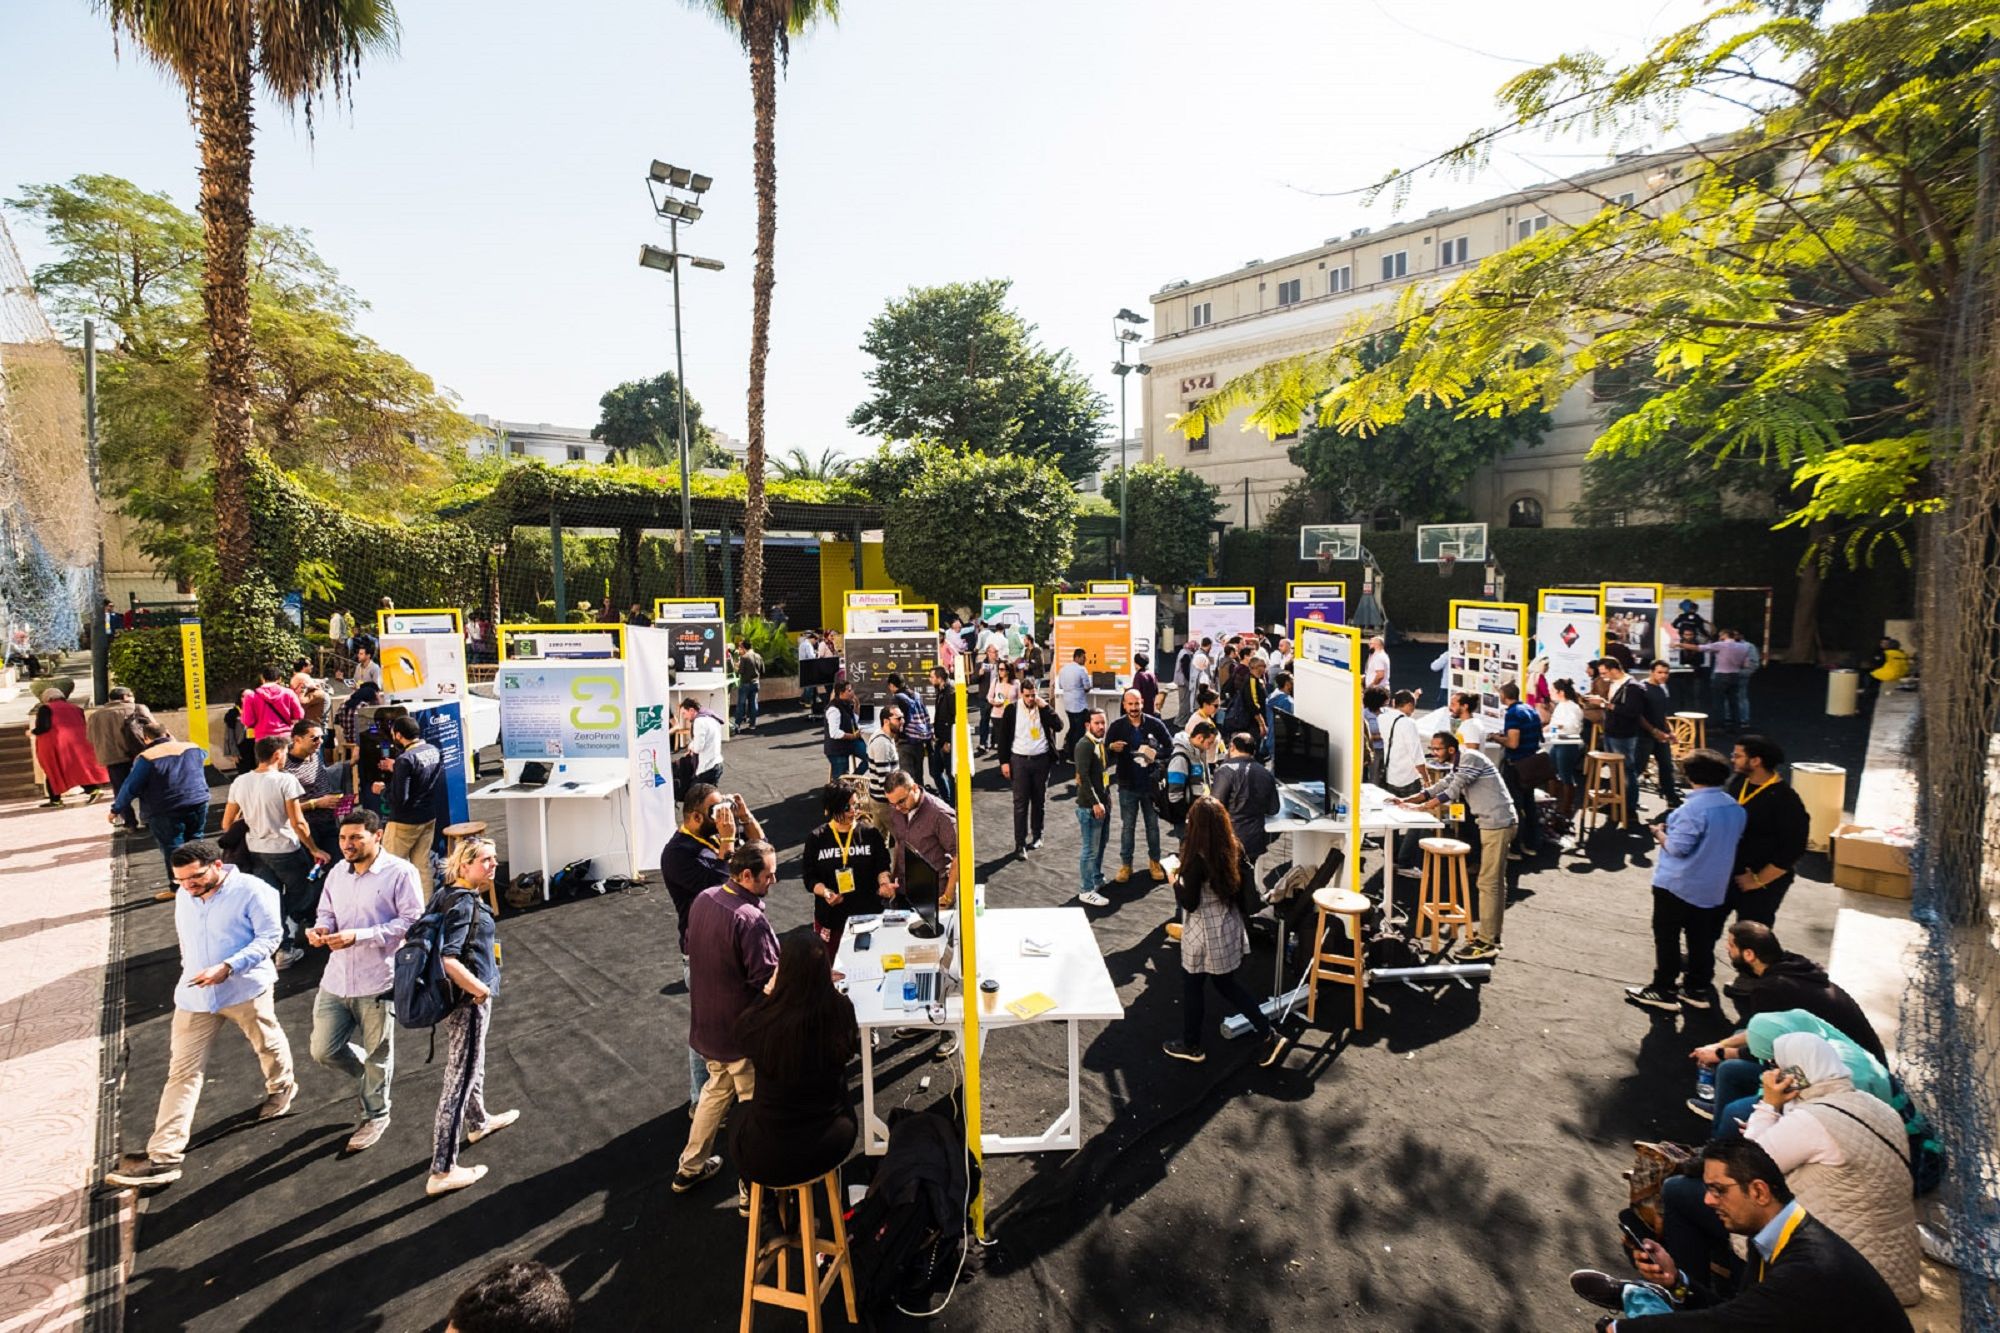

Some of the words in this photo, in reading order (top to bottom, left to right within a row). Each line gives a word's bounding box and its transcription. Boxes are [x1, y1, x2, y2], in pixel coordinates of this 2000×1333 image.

[859, 594, 894, 603] Affectiva
[190, 632, 199, 668] STATION
[574, 732, 620, 741] ZeroPrime
[574, 742, 620, 750] Technologies
[638, 748, 654, 790] GESR
